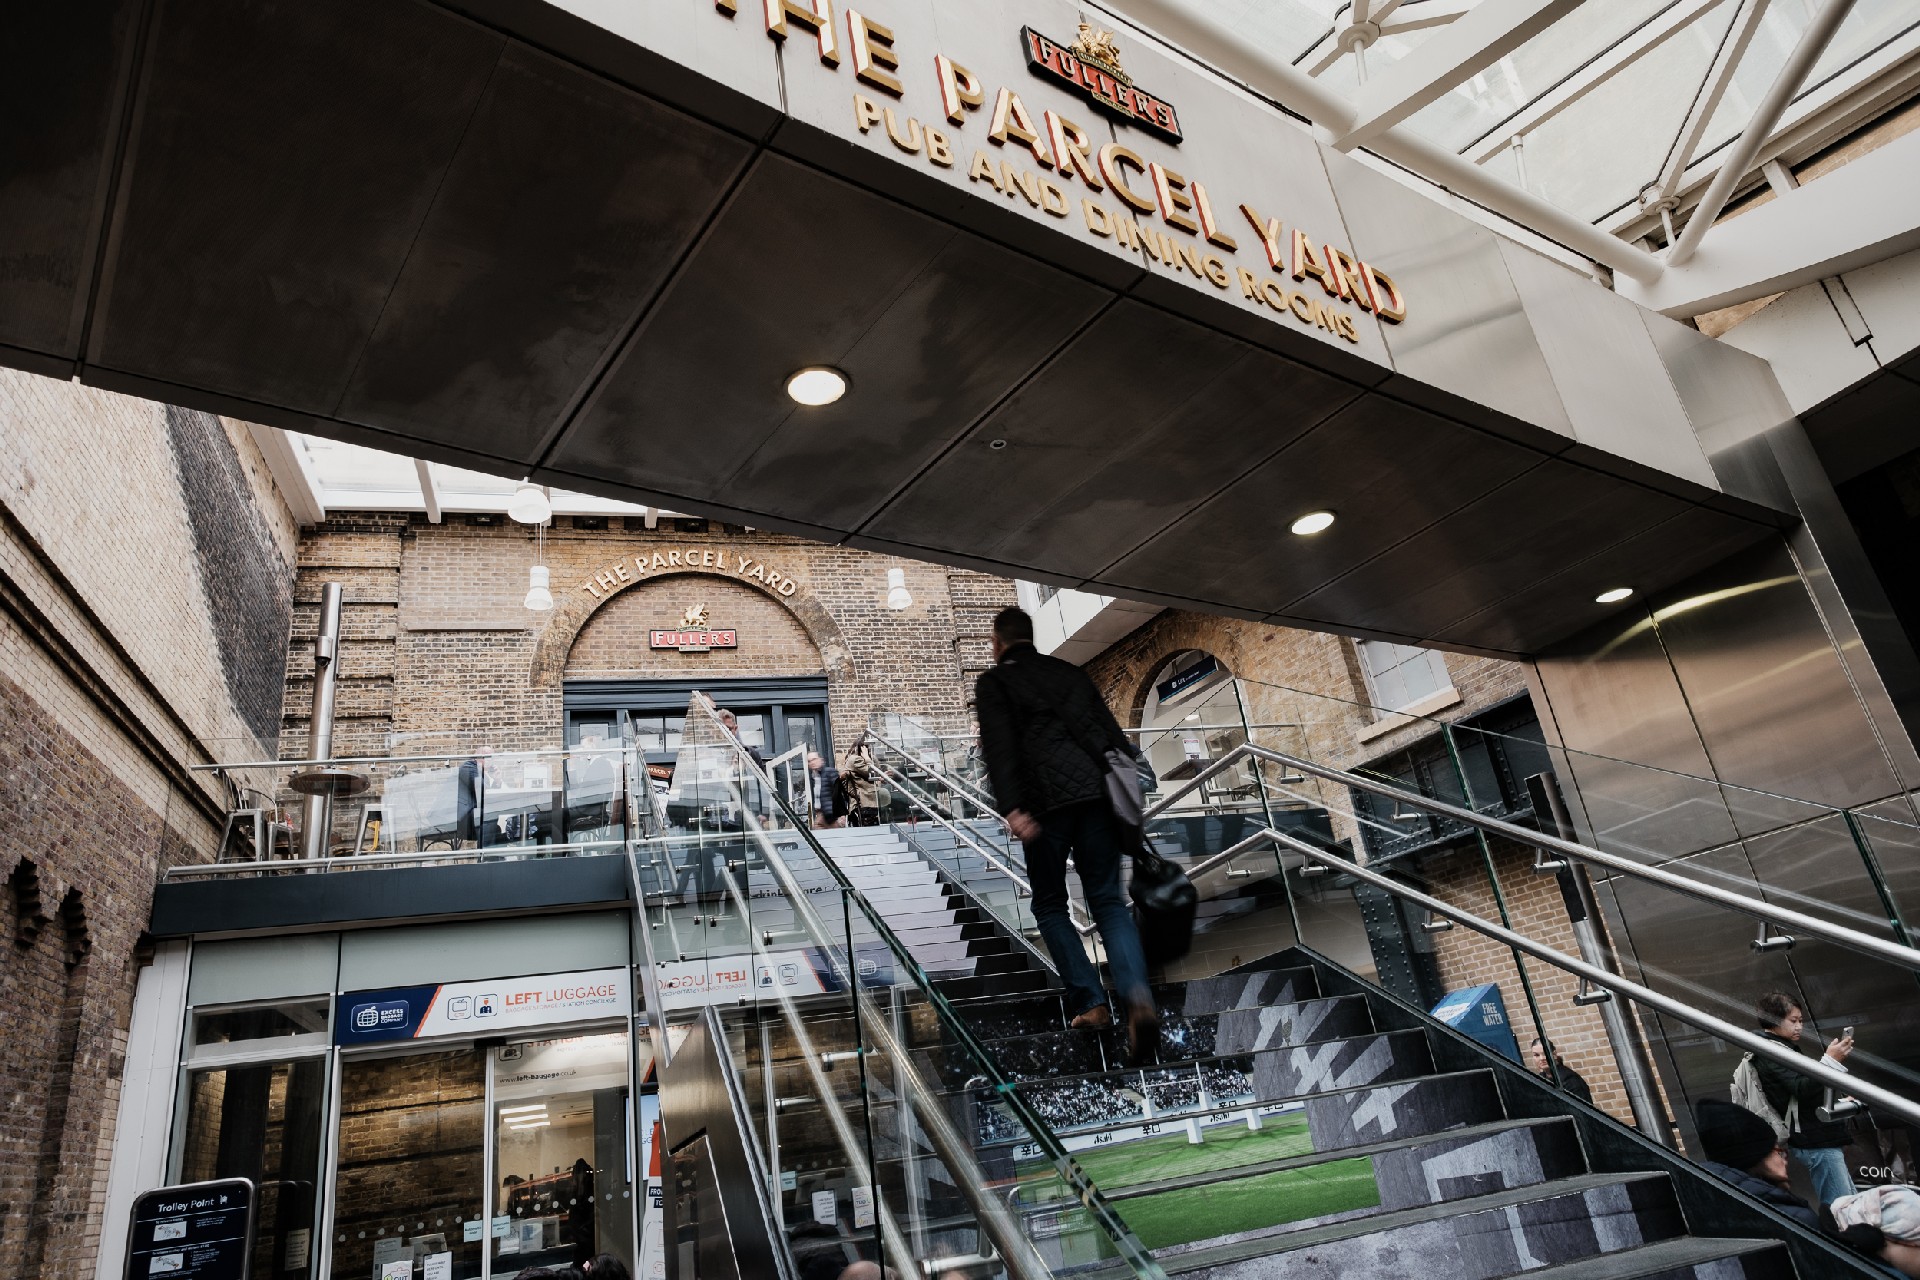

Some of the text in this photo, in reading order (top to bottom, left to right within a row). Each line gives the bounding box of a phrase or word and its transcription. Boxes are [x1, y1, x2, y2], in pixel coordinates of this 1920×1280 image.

[715, 0, 1406, 325] HE PARCEL YARD
[853, 92, 1360, 345] PUB AND DINING ROOMS
[583, 549, 796, 598] THE PARCEL YARD
[655, 631, 731, 645] FULLER'S
[505, 984, 617, 1006] LEFT LUGGAGE
[380, 1008, 404, 1016] EXCESS
[1481, 1002, 1498, 1014] FREE
[1482, 1013, 1504, 1026] WATER
[650, 1187, 663, 1196] FRO
[158, 1197, 214, 1213] Trolley Point
